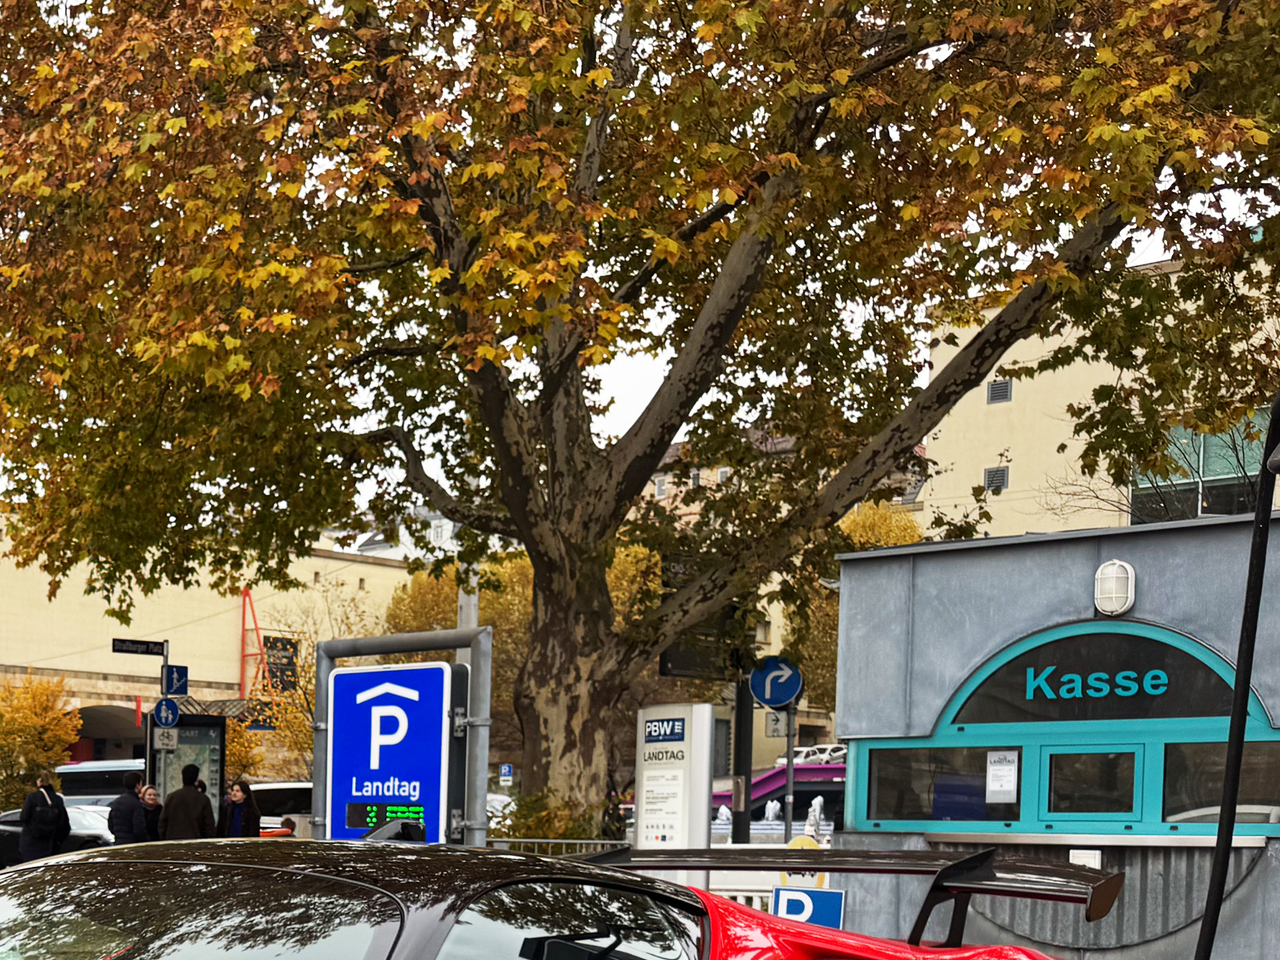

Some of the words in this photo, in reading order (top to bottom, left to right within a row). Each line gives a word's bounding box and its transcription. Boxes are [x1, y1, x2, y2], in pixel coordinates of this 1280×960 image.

[1026, 666, 1169, 700] Kasse
[370, 705, 409, 770] P
[645, 721, 673, 736] PBW
[643, 750, 685, 762] LANDTAG
[352, 777, 420, 801] Landtag
